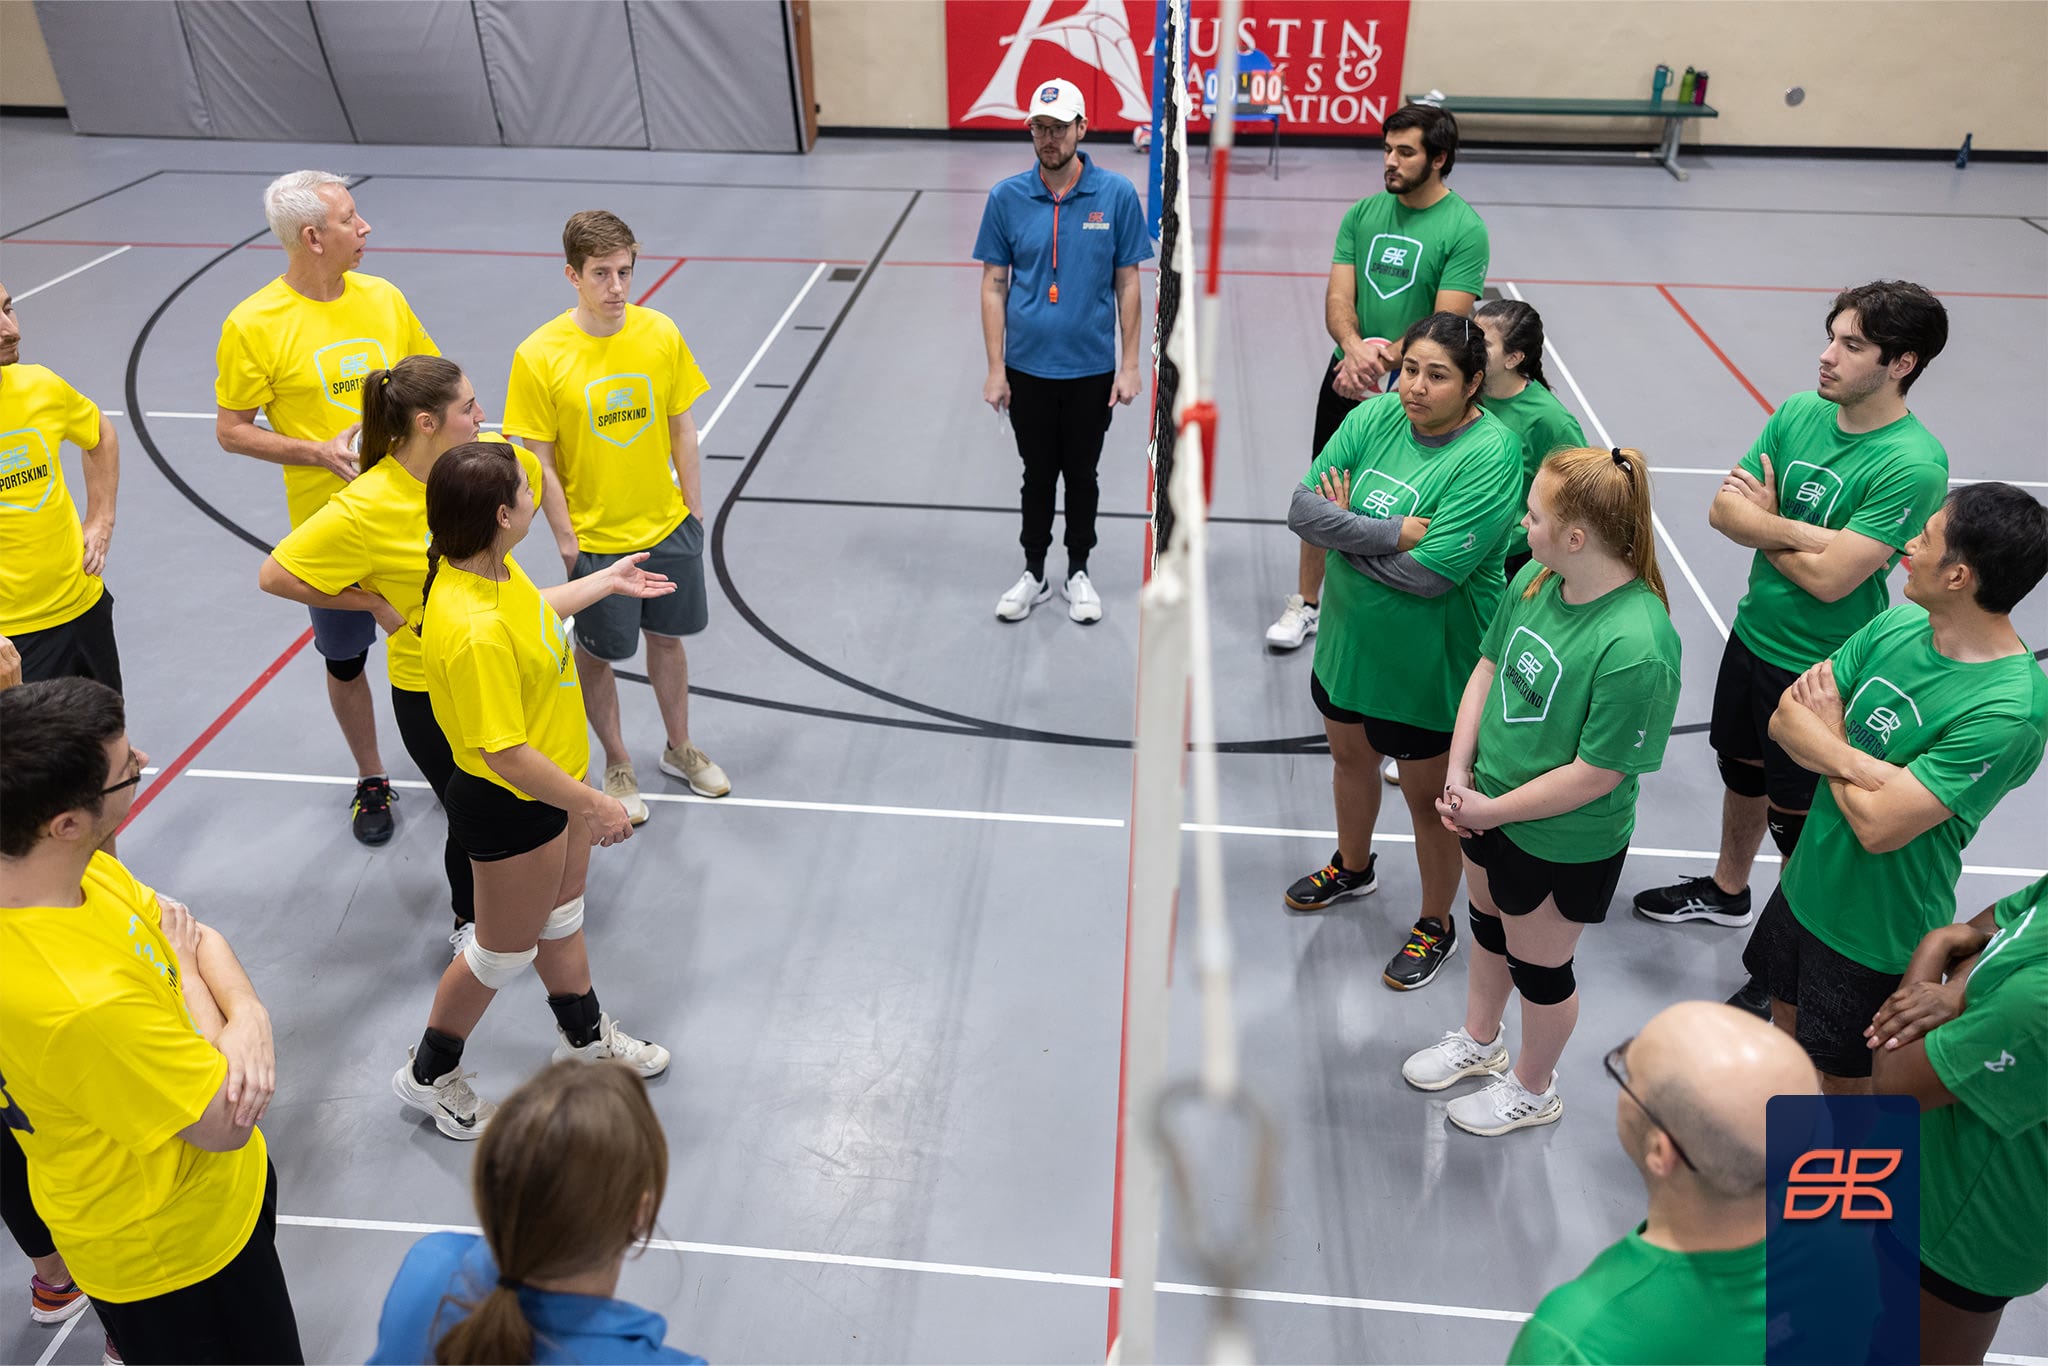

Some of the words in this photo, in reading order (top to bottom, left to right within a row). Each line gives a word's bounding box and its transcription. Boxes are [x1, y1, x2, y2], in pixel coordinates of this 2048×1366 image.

[1144, 17, 1382, 58] USTIN
[1186, 93, 1388, 125] EATION
[332, 377, 365, 395] SPORT
[598, 407, 647, 427] SPORTSKIND
[0, 464, 48, 492] PORTSKIND
[1505, 664, 1544, 709] SPORTSKIND
